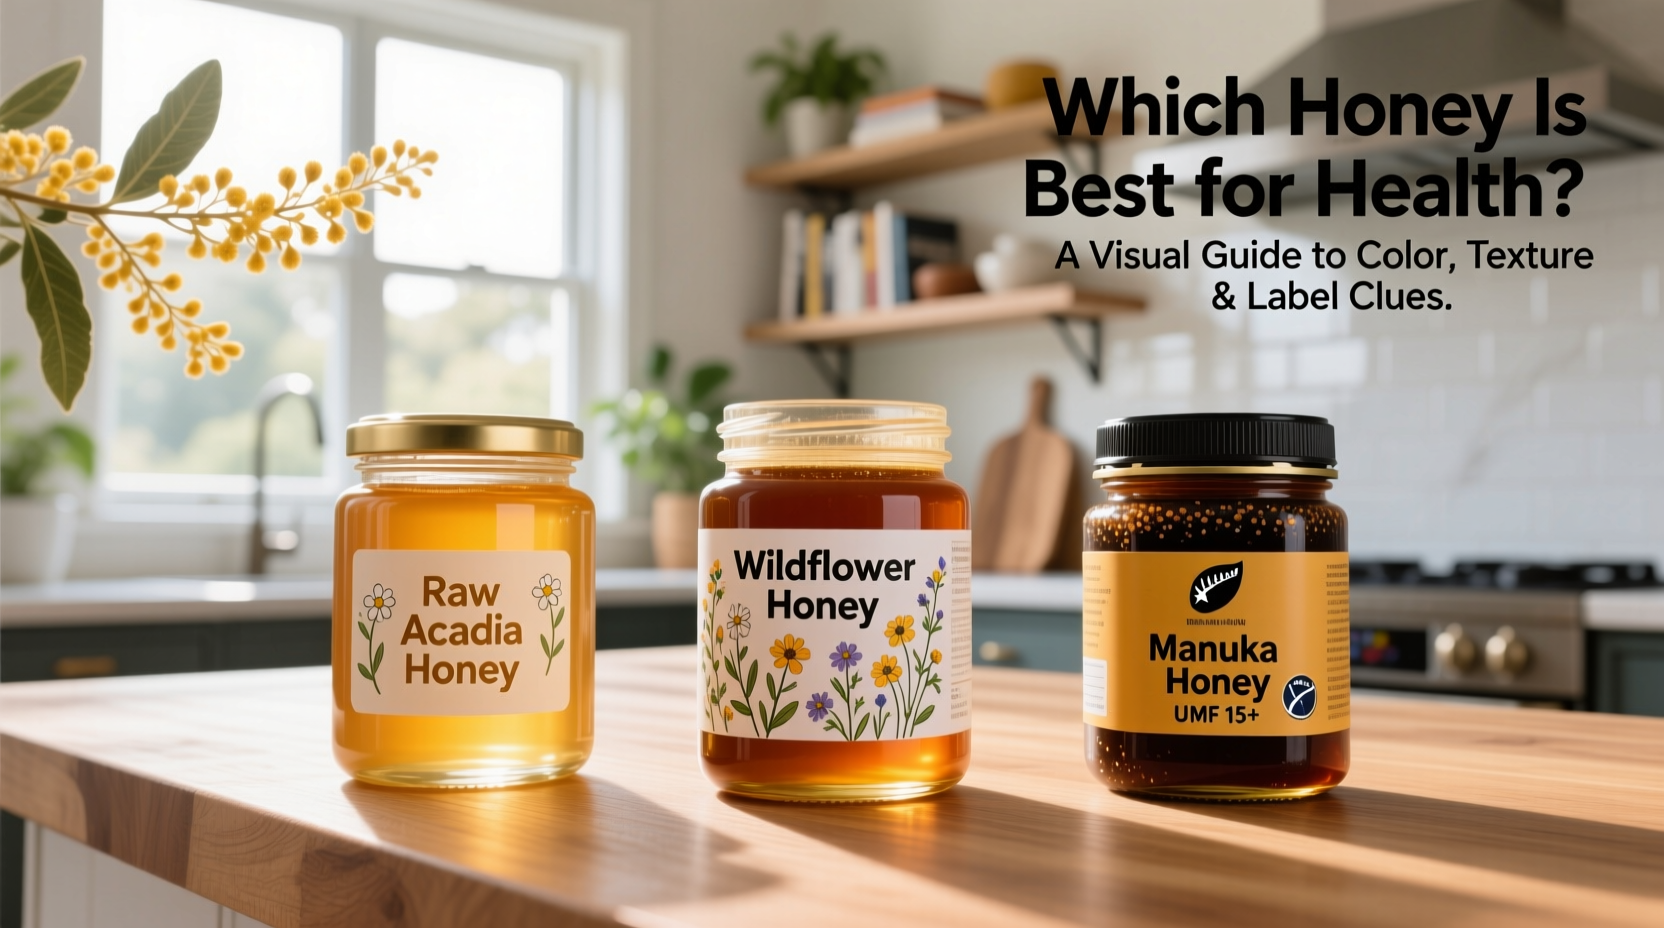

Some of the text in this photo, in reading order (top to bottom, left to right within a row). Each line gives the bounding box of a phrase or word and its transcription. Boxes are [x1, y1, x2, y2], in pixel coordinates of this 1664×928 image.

[733, 548, 916, 582] Wildflower
[422, 575, 501, 608] Raw
[767, 588, 880, 629] Honey
[400, 612, 523, 647] Acadia
[1149, 632, 1278, 663] Manuka
[405, 652, 520, 693] Honey
[1166, 667, 1271, 703] Honey
[1174, 705, 1260, 724] UMF 15+
